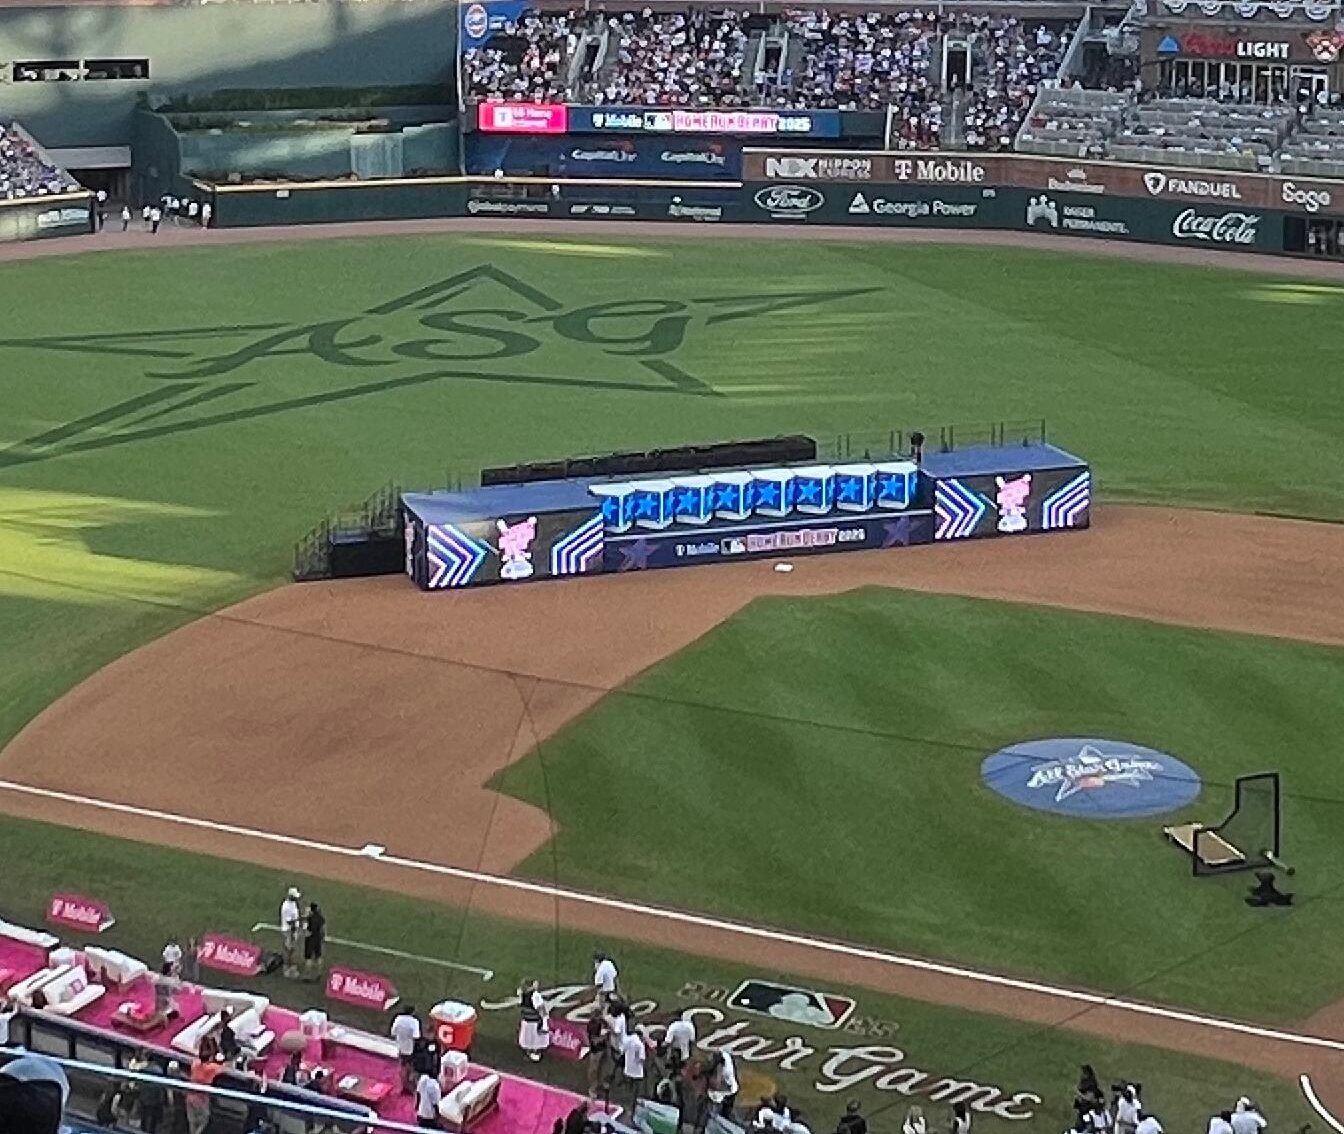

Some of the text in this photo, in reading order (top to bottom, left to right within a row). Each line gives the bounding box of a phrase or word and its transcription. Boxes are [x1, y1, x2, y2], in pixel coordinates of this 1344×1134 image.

[1237, 42, 1289, 58] LIGHT
[917, 161, 984, 182] Mobile
[765, 187, 812, 210] Ford
[1169, 178, 1241, 199] FANDUEL
[873, 198, 978, 218] Georgia Power
[216, 944, 255, 968] Mobile
[345, 976, 386, 1002] Mobile
[815, 1044, 1042, 1120] Game
